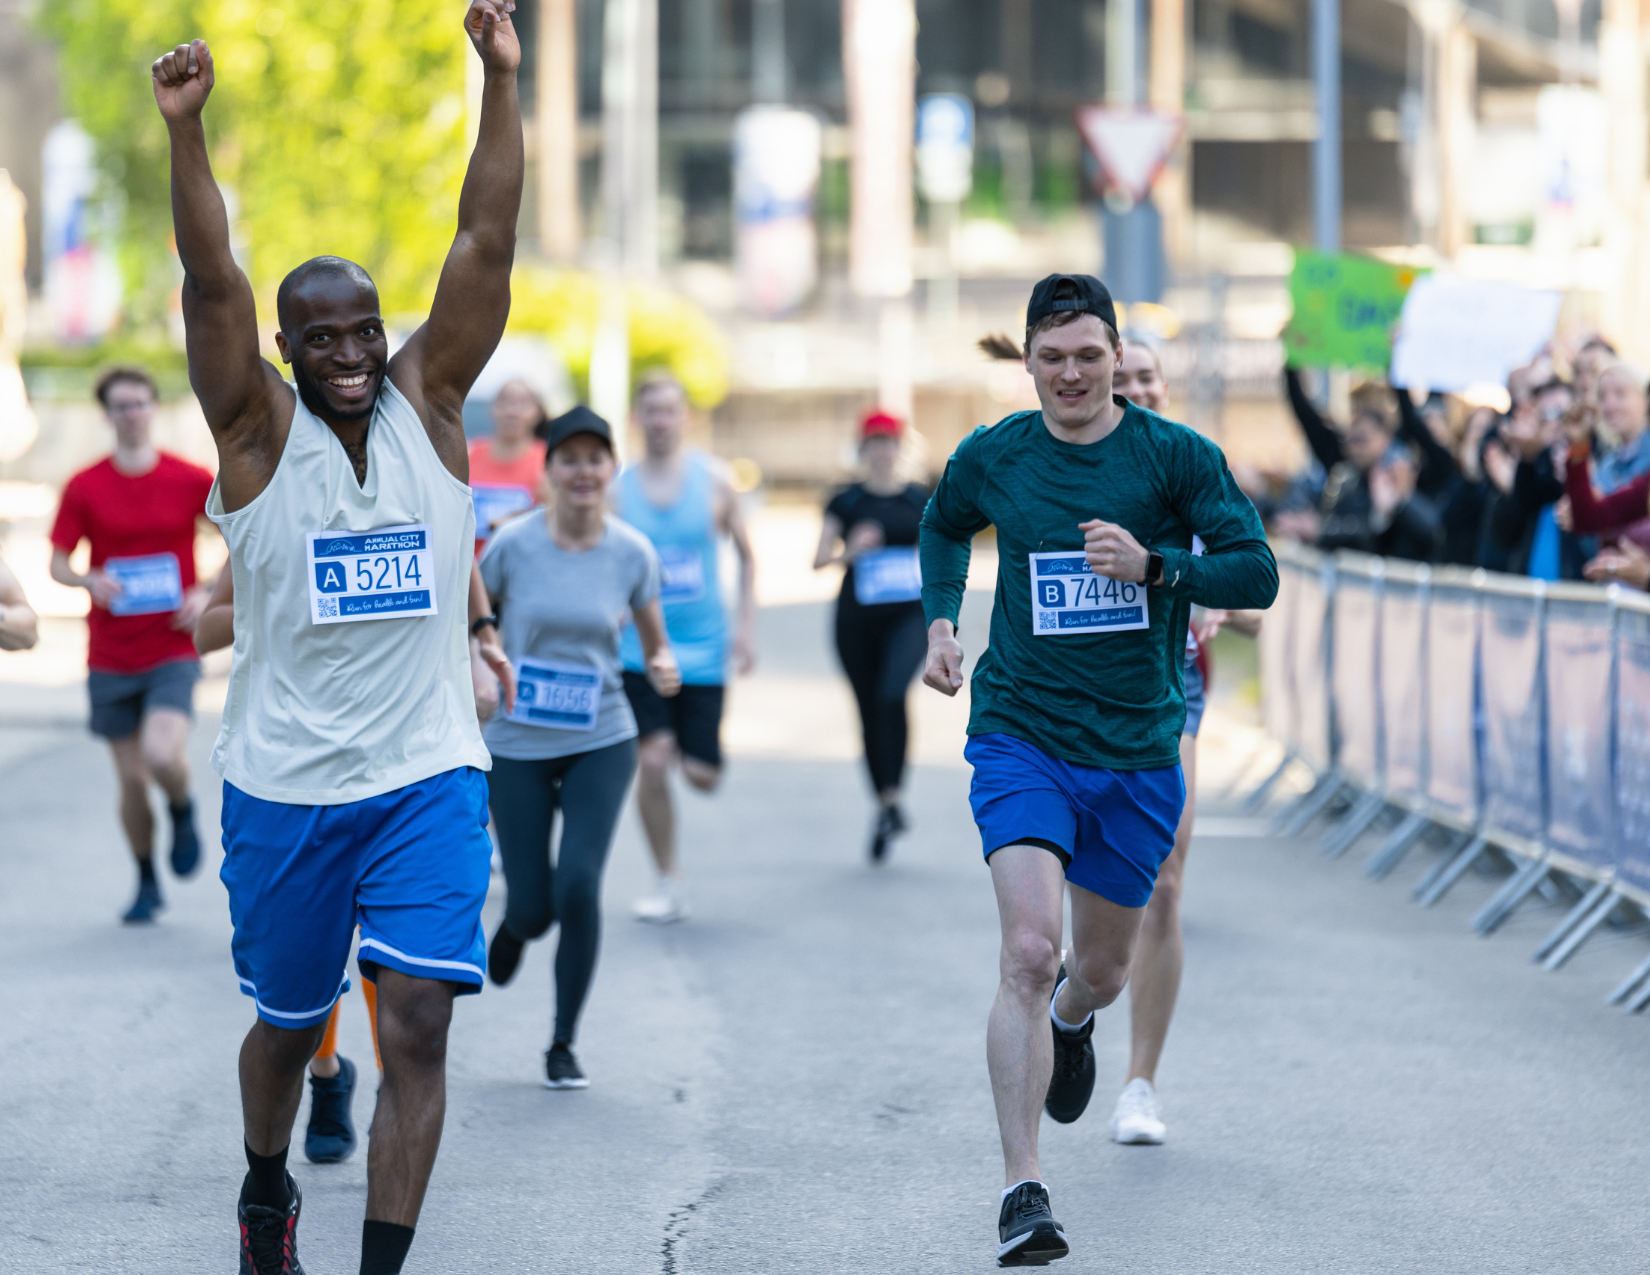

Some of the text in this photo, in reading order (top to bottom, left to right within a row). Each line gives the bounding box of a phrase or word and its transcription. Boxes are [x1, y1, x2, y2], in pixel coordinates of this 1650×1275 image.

[364, 534, 420, 545] ANNUAL CITY
[364, 540, 420, 552] MARATHON
[323, 555, 422, 591] A 5214
[346, 592, 424, 612] Run for health and fun!
[1045, 577, 1137, 607] B 7446
[1065, 608, 1136, 626] Run for health and fun!
[543, 685, 593, 712] 1656
